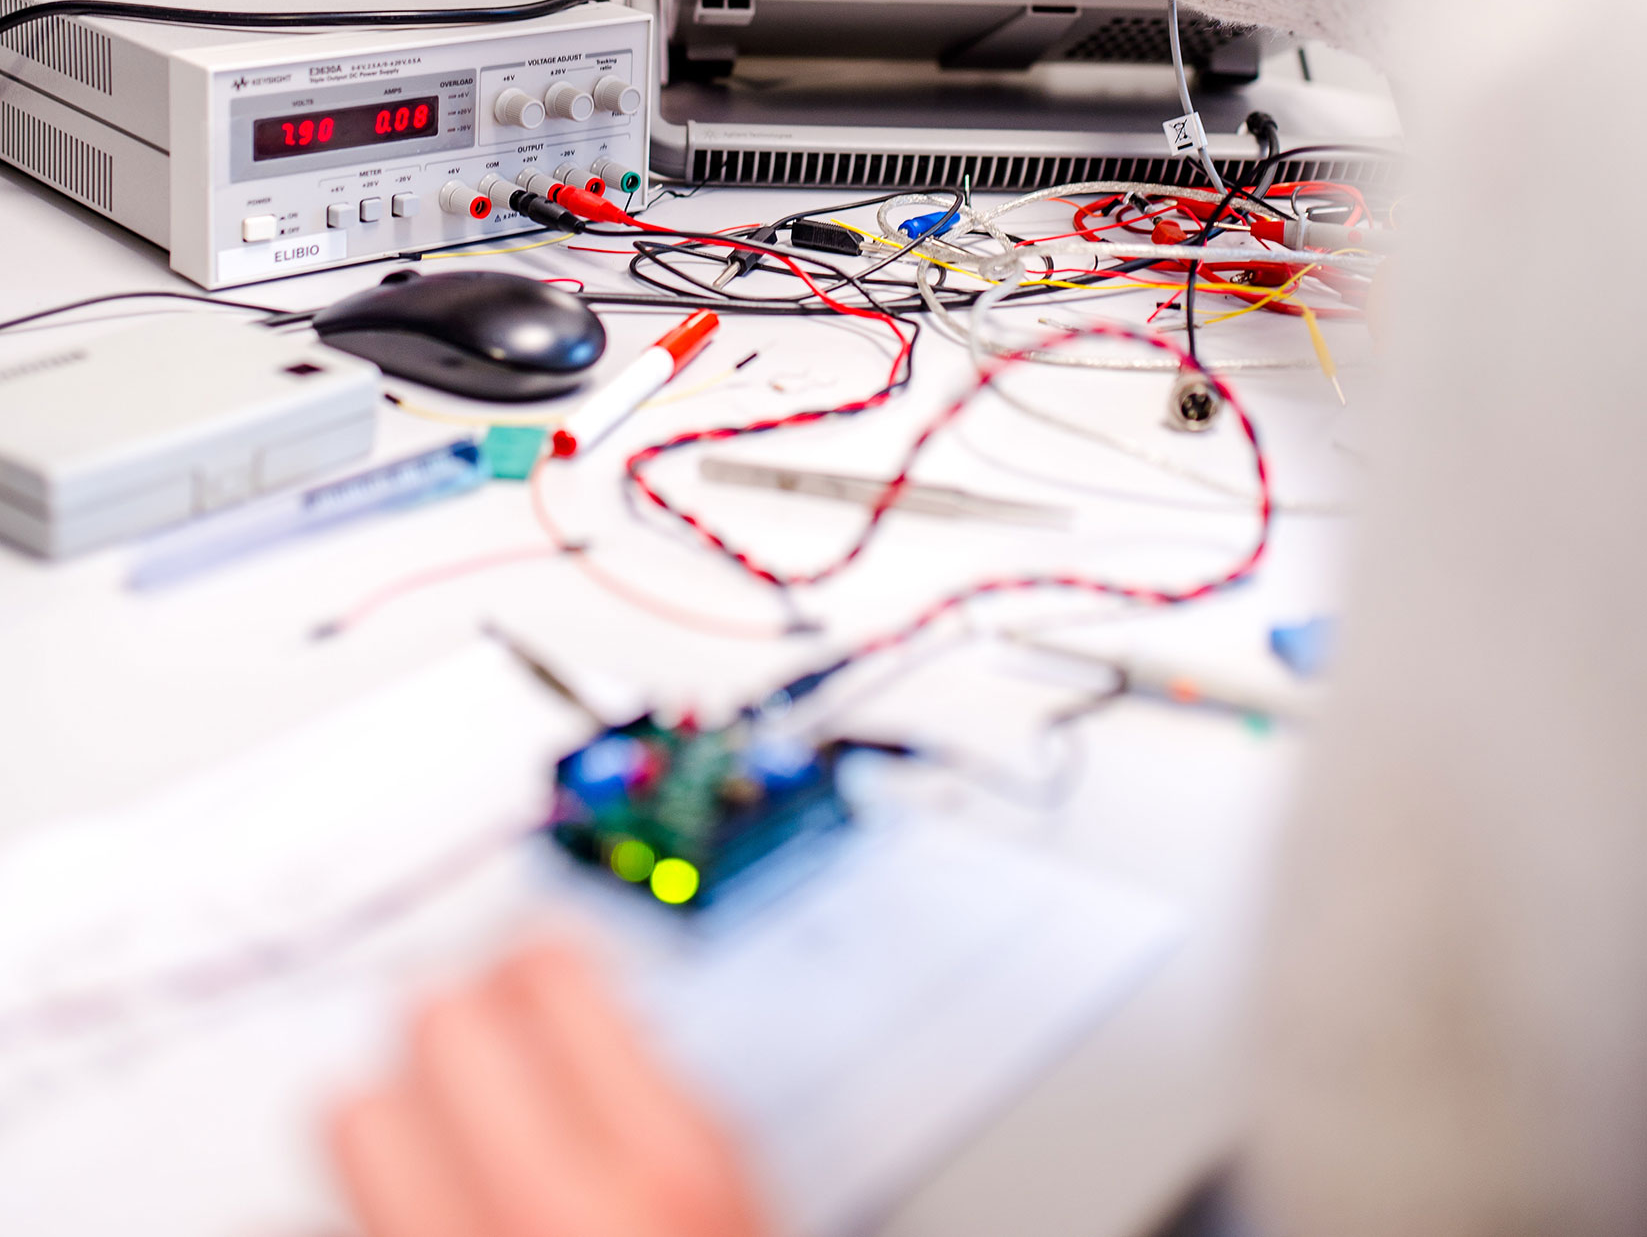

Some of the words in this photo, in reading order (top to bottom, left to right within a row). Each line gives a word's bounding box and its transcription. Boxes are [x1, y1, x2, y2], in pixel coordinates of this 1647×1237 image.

[527, 56, 556, 67] VOLTAGE
[557, 53, 582, 63] ADJUST
[440, 77, 474, 89] OVERLOAD
[383, 87, 402, 96] AMPS
[374, 103, 429, 135] 0.08
[517, 143, 544, 154] OUTPUT
[485, 161, 500, 170] COM
[359, 168, 382, 178] METER
[274, 243, 320, 263] ELIBIO
